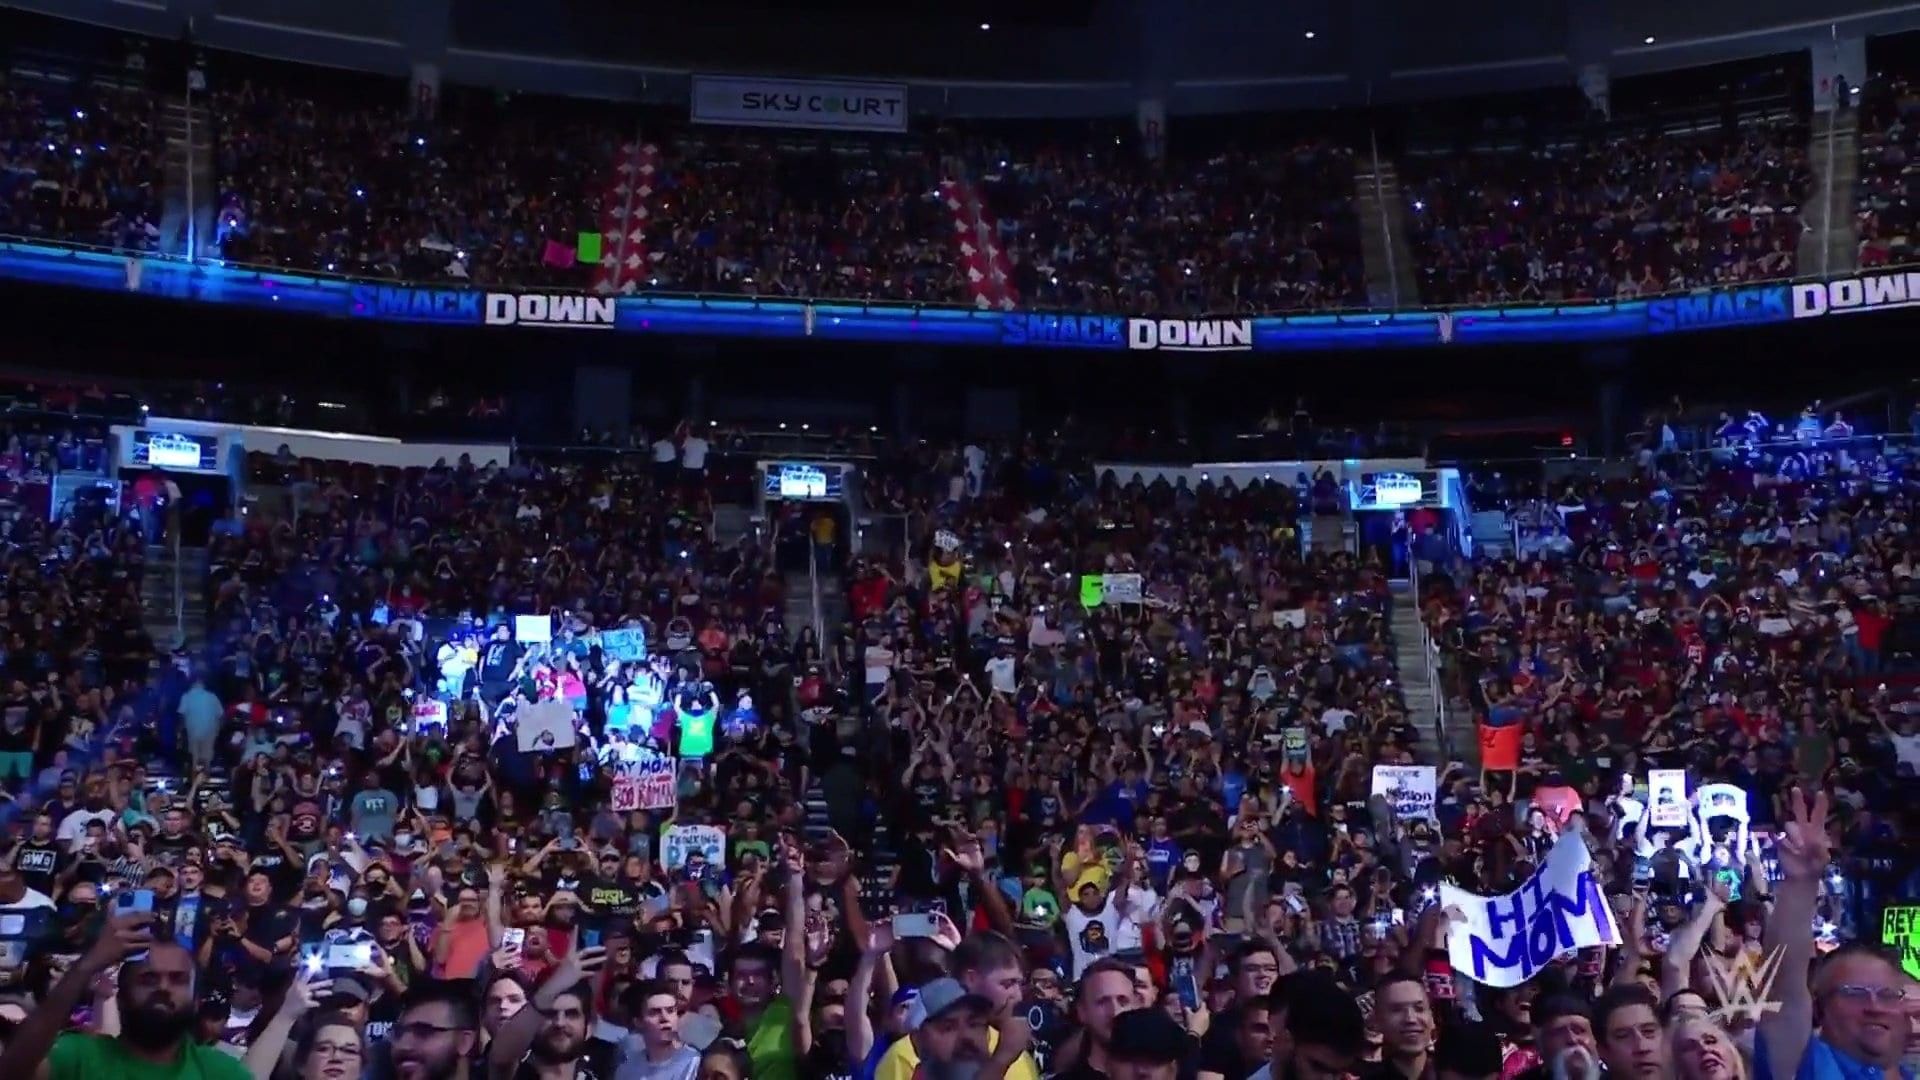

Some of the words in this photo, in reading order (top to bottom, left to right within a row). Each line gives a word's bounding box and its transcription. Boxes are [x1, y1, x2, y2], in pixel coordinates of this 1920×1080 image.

[1470, 870, 1613, 979] MOM
[1486, 860, 1549, 939] HI
[1886, 908, 1917, 934] REY
